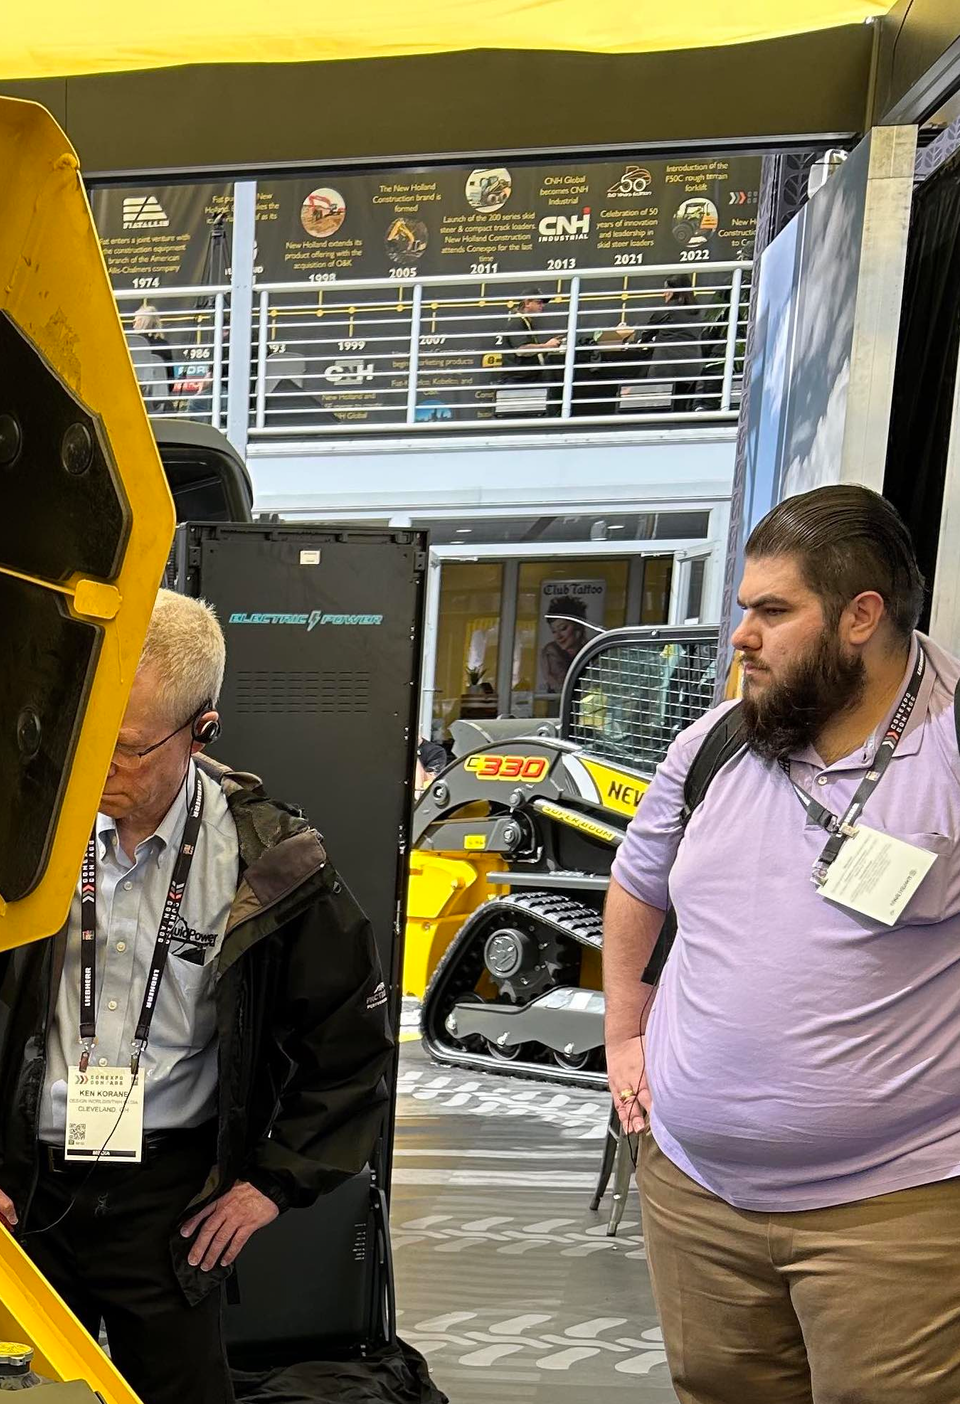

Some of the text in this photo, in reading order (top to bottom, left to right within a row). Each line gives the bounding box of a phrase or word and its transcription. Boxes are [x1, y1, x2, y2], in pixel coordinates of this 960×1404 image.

[666, 164, 708, 172] Introduction
[717, 162, 728, 170] the
[544, 176, 586, 186] CNH Global
[665, 174, 684, 182] F50C
[685, 174, 705, 182] rough
[393, 184, 410, 192] New
[410, 182, 436, 191] Holland
[540, 186, 589, 196] becomes CNH
[684, 183, 708, 192] forklift
[372, 194, 415, 204] Construction
[416, 193, 434, 201] brand
[548, 196, 579, 206] Industrial
[394, 204, 419, 212] formed
[600, 208, 658, 218] Celebration of 50
[442, 215, 466, 224] Launch
[467, 214, 475, 222] of
[476, 214, 488, 222] the
[522, 212, 536, 220] skid
[731, 218, 749, 226] New
[464, 226, 492, 234] compact
[493, 224, 510, 232] track
[596, 219, 658, 230] years of innovation
[538, 234, 589, 242] INDUSTRIAL
[598, 230, 612, 238] and
[612, 229, 646, 238] leadership
[444, 234, 532, 244] New Holland Construction
[630, 238, 654, 247] loaders
[114, 246, 152, 254] construction
[153, 244, 186, 253] equipment
[285, 242, 302, 250] New
[302, 240, 328, 249] Holland
[328, 239, 354, 247] extends
[441, 246, 466, 254] attends
[466, 244, 497, 254] Conexpo
[498, 244, 508, 252] for
[508, 243, 520, 251] the
[150, 254, 180, 263] American
[284, 252, 310, 260] product
[310, 250, 335, 259] offering
[614, 252, 644, 265] 2021
[680, 249, 710, 262] 2022
[293, 262, 326, 270] acquisition
[327, 260, 336, 268] of
[470, 262, 498, 274] 2011
[547, 258, 577, 270] 2013
[152, 266, 180, 274] company
[388, 266, 418, 278] 2005
[308, 272, 337, 282] 1998
[132, 276, 160, 289] 1974
[338, 340, 366, 351] 1999
[543, 583, 603, 596] Club Tattoo
[228, 613, 384, 625] ELECTRIC POWER
[890, 692, 912, 730] CONEXPO
[580, 822, 614, 838] BOOM
[84, 967, 92, 1007] LIEBHERR
[146, 969, 160, 1009] LIEBHERR
[97, 1090, 128, 1098] KORANE
